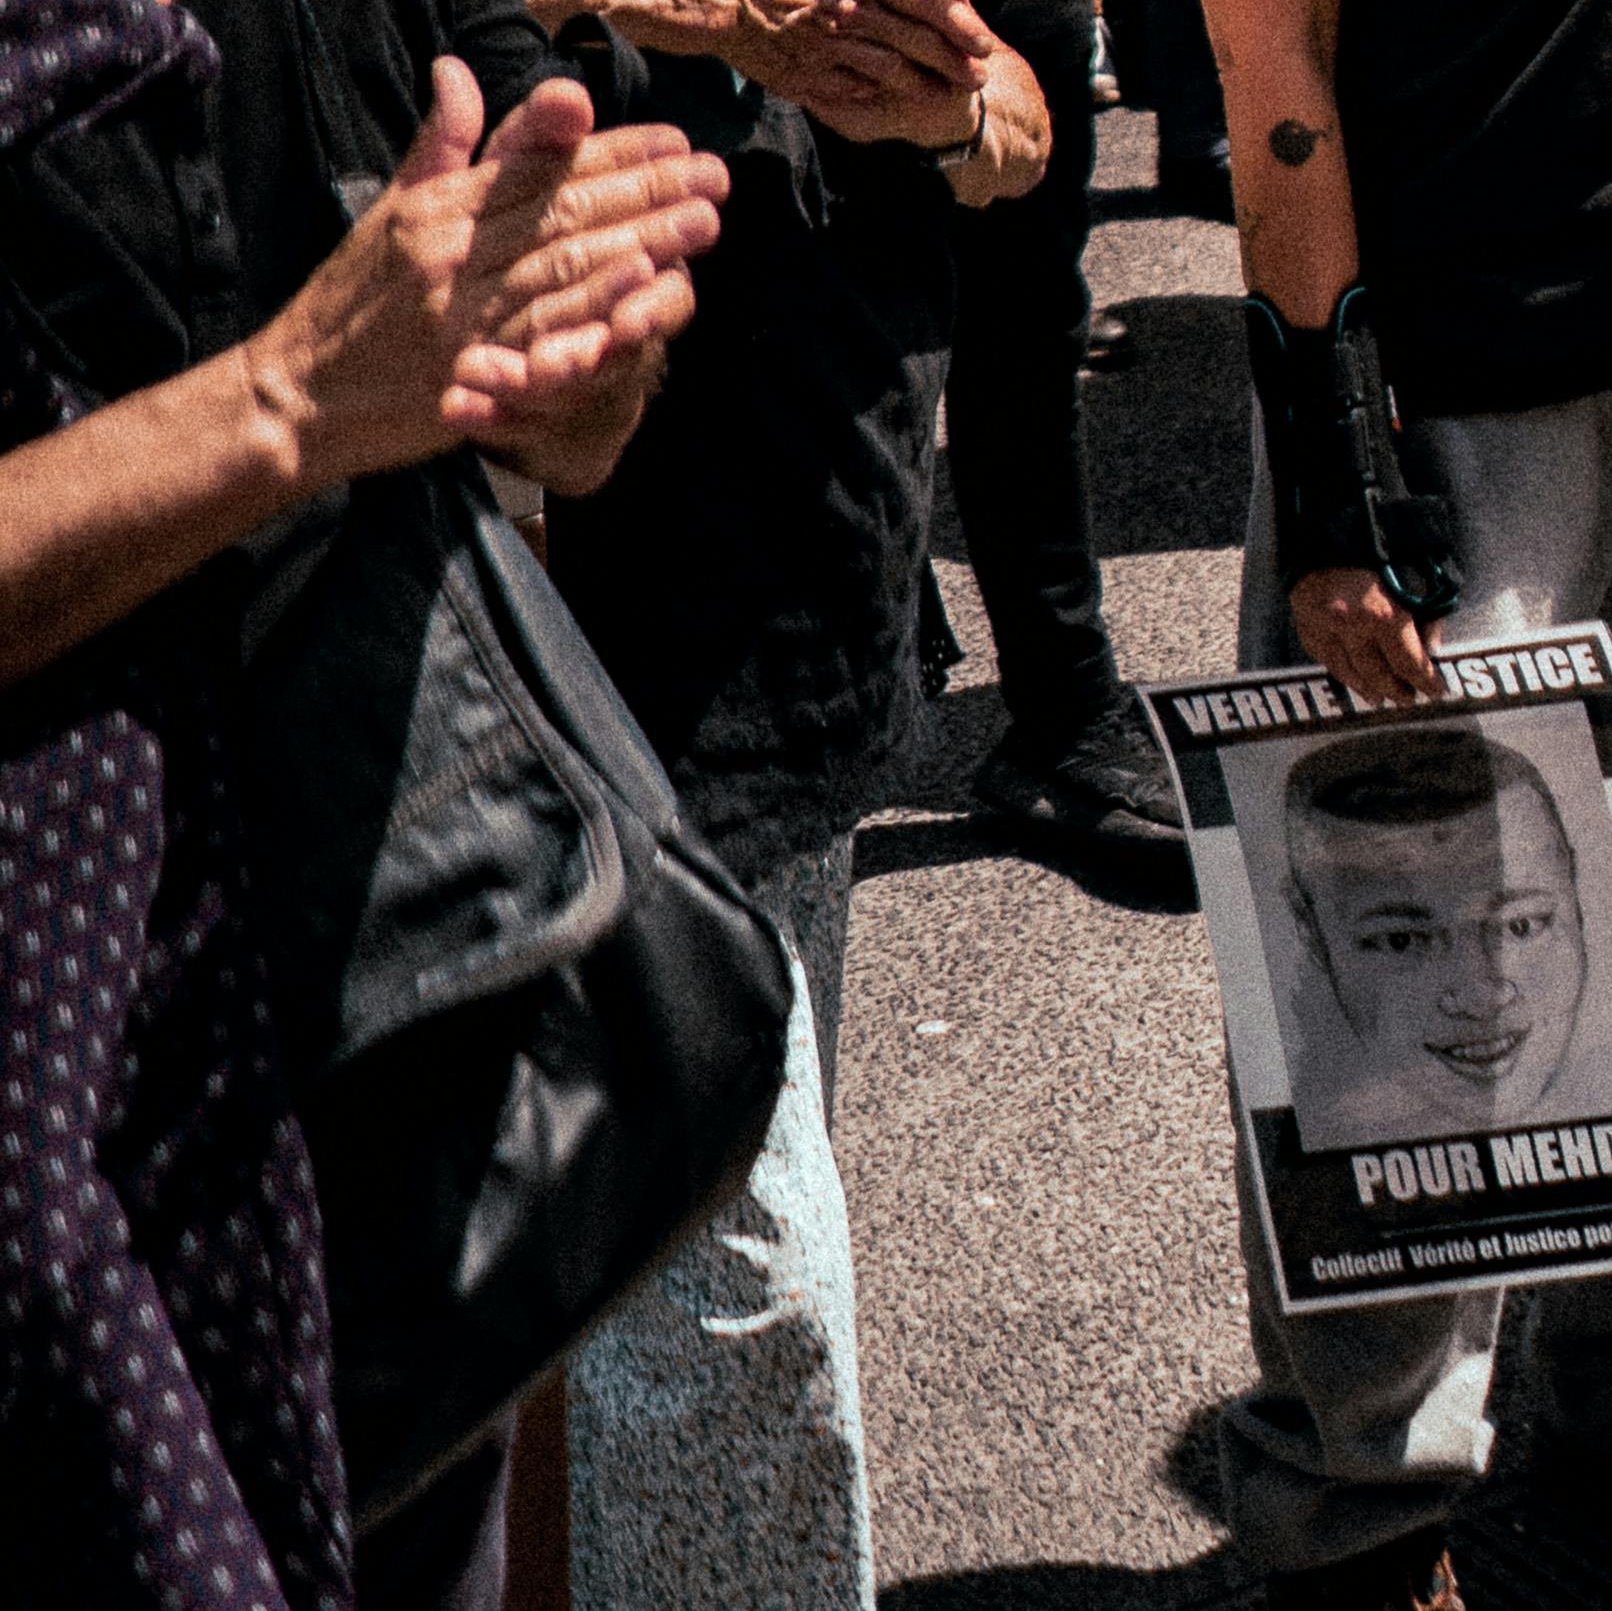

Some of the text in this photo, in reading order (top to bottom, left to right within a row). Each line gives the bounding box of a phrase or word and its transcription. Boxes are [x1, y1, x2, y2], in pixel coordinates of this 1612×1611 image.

[1173, 679, 1342, 737] VERITE
[1415, 643, 1603, 705] USTICE
[1352, 1142, 1486, 1206] POUR
[1311, 1247, 1403, 1281] Collectif
[1408, 1239, 1477, 1271] Vérité
[1477, 1235, 1503, 1260] et
[1505, 1225, 1581, 1257] Justice
